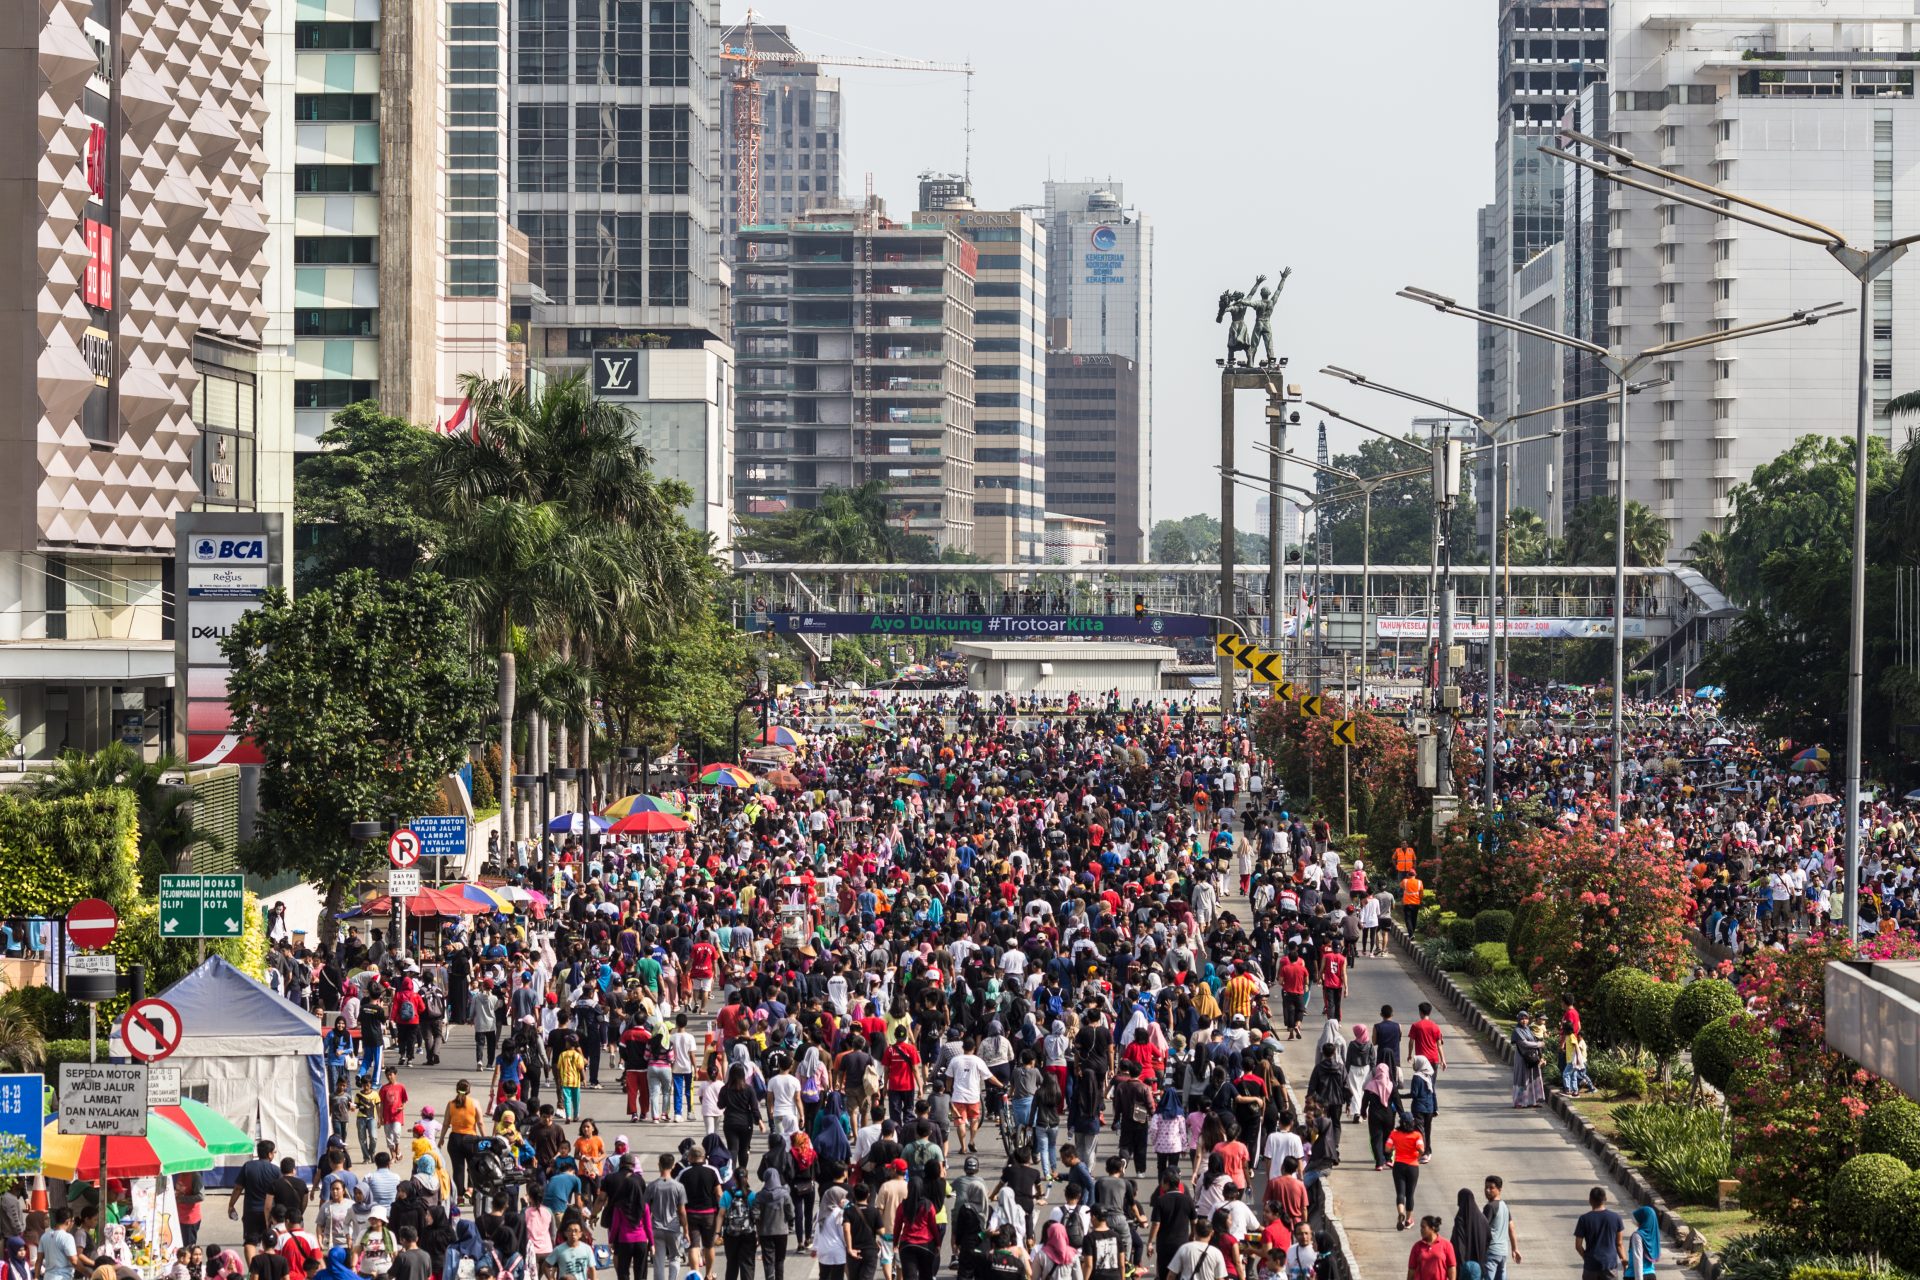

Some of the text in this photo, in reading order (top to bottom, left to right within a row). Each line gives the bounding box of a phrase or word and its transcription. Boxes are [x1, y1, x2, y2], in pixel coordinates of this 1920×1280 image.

[967, 215, 1012, 224] POINTS
[211, 463, 233, 483] COACH
[219, 541, 263, 558] BCA
[213, 573, 242, 582] Regus
[870, 615, 1104, 633] Ayo Dukung #TrotoarKita
[192, 626, 230, 638] DELL
[162, 880, 200, 888] TN. ABANG
[204, 880, 236, 888] MONAS
[162, 890, 200, 898] PEJOMPONGAN
[204, 890, 242, 898] HARMONI
[162, 900, 183, 908] SLIPI
[204, 900, 228, 908] KOTA
[1330, 961, 1338, 974] 5
[65, 1069, 141, 1079] SEPEDA MOTOR
[71, 1082, 135, 1091] WAJIB JALUR
[13, 1085, 20, 1098] 23
[83, 1095, 122, 1104] LAMBAT
[13, 1100, 20, 1113] 23
[65, 1107, 139, 1117] DAN NYALAKAN
[86, 1120, 119, 1129] LAMPU
